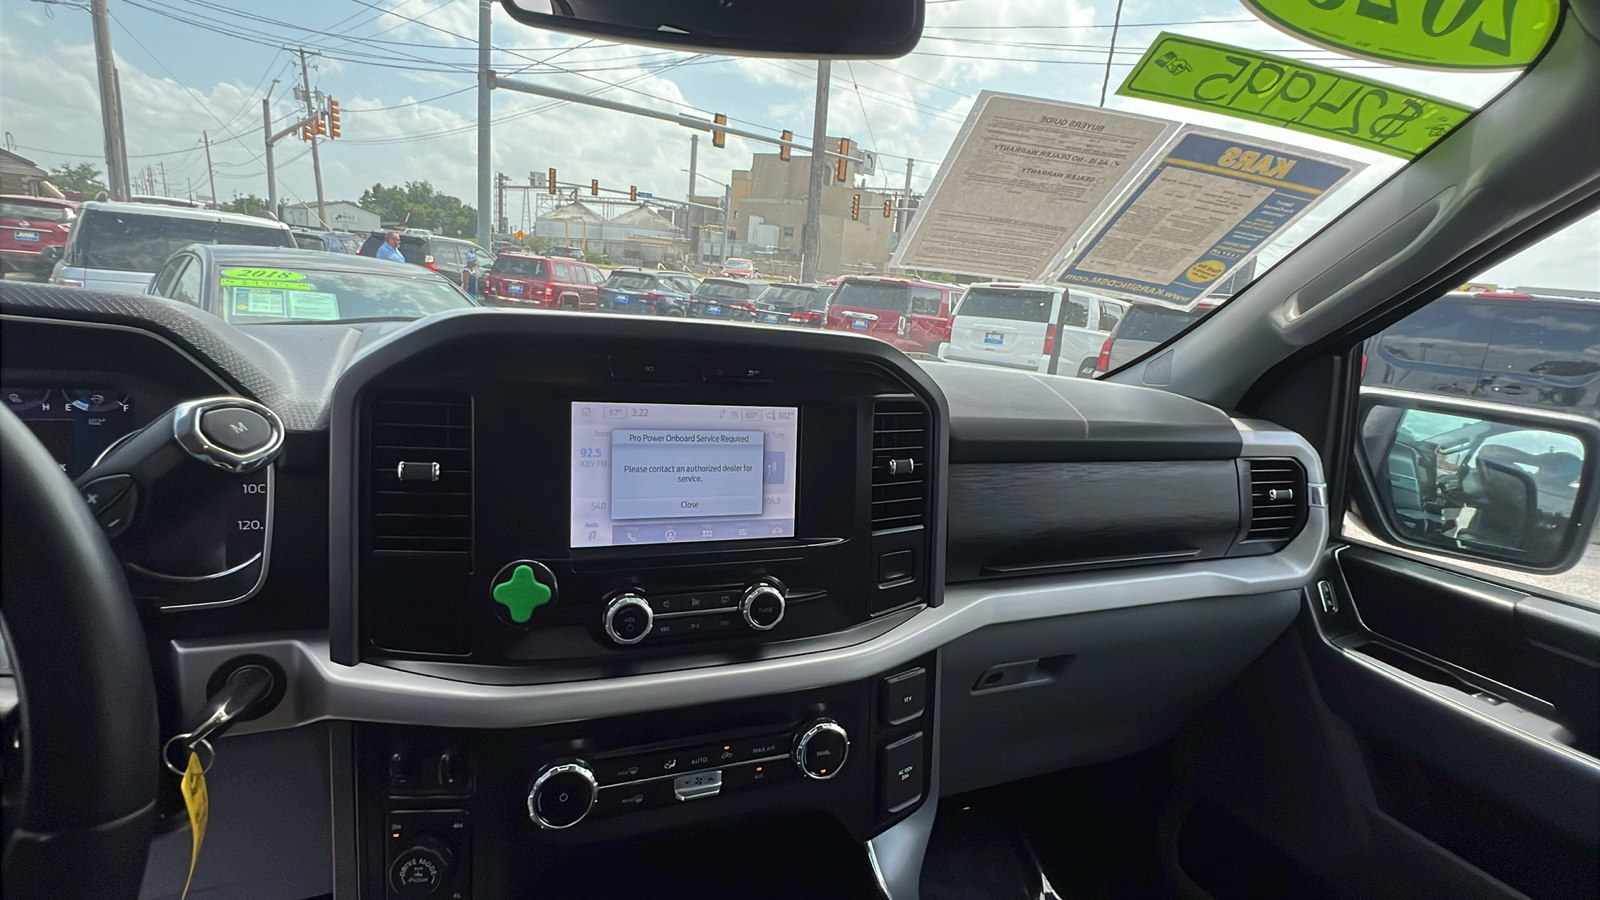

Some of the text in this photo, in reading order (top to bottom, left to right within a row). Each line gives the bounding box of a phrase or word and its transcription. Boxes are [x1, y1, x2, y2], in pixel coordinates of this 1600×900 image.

[236, 268, 293, 279] 2018
[65, 403, 72, 411] E
[123, 404, 129, 412] F
[631, 408, 649, 417] 3:22
[230, 421, 249, 434] M
[629, 434, 750, 444] Pro Power Onboard Service Required
[580, 448, 602, 458] 92.5
[624, 465, 648, 473] Please
[648, 465, 675, 473] contact
[685, 465, 722, 473] authorized
[722, 465, 742, 473] dealer
[591, 502, 607, 510] 540
[680, 501, 699, 509] Close
[691, 756, 708, 765] AUTO
[399, 857, 438, 877] DRIVE MODE
